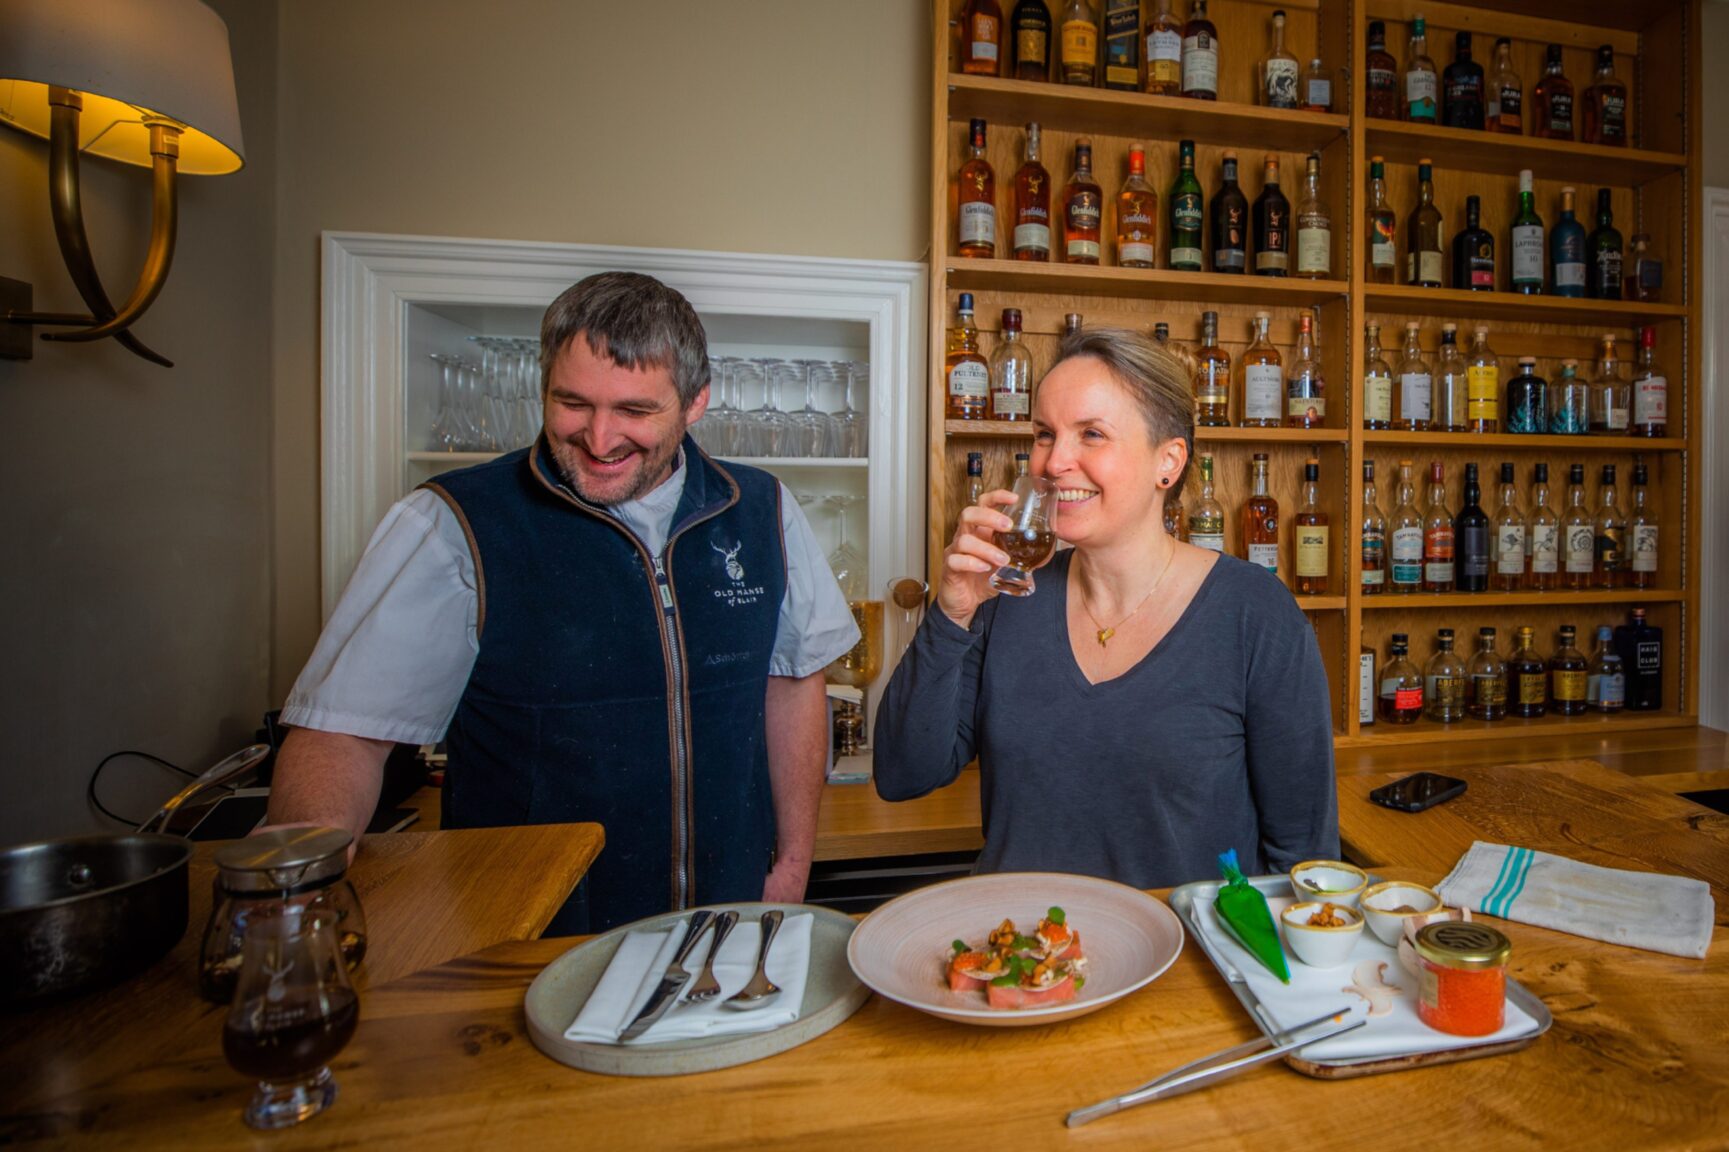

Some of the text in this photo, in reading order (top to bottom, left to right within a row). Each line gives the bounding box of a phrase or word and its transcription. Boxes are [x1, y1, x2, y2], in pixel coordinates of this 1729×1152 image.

[953, 383, 963, 391] 12
[714, 586, 764, 598] OLD MANSE
[737, 596, 757, 604] BLAIR
